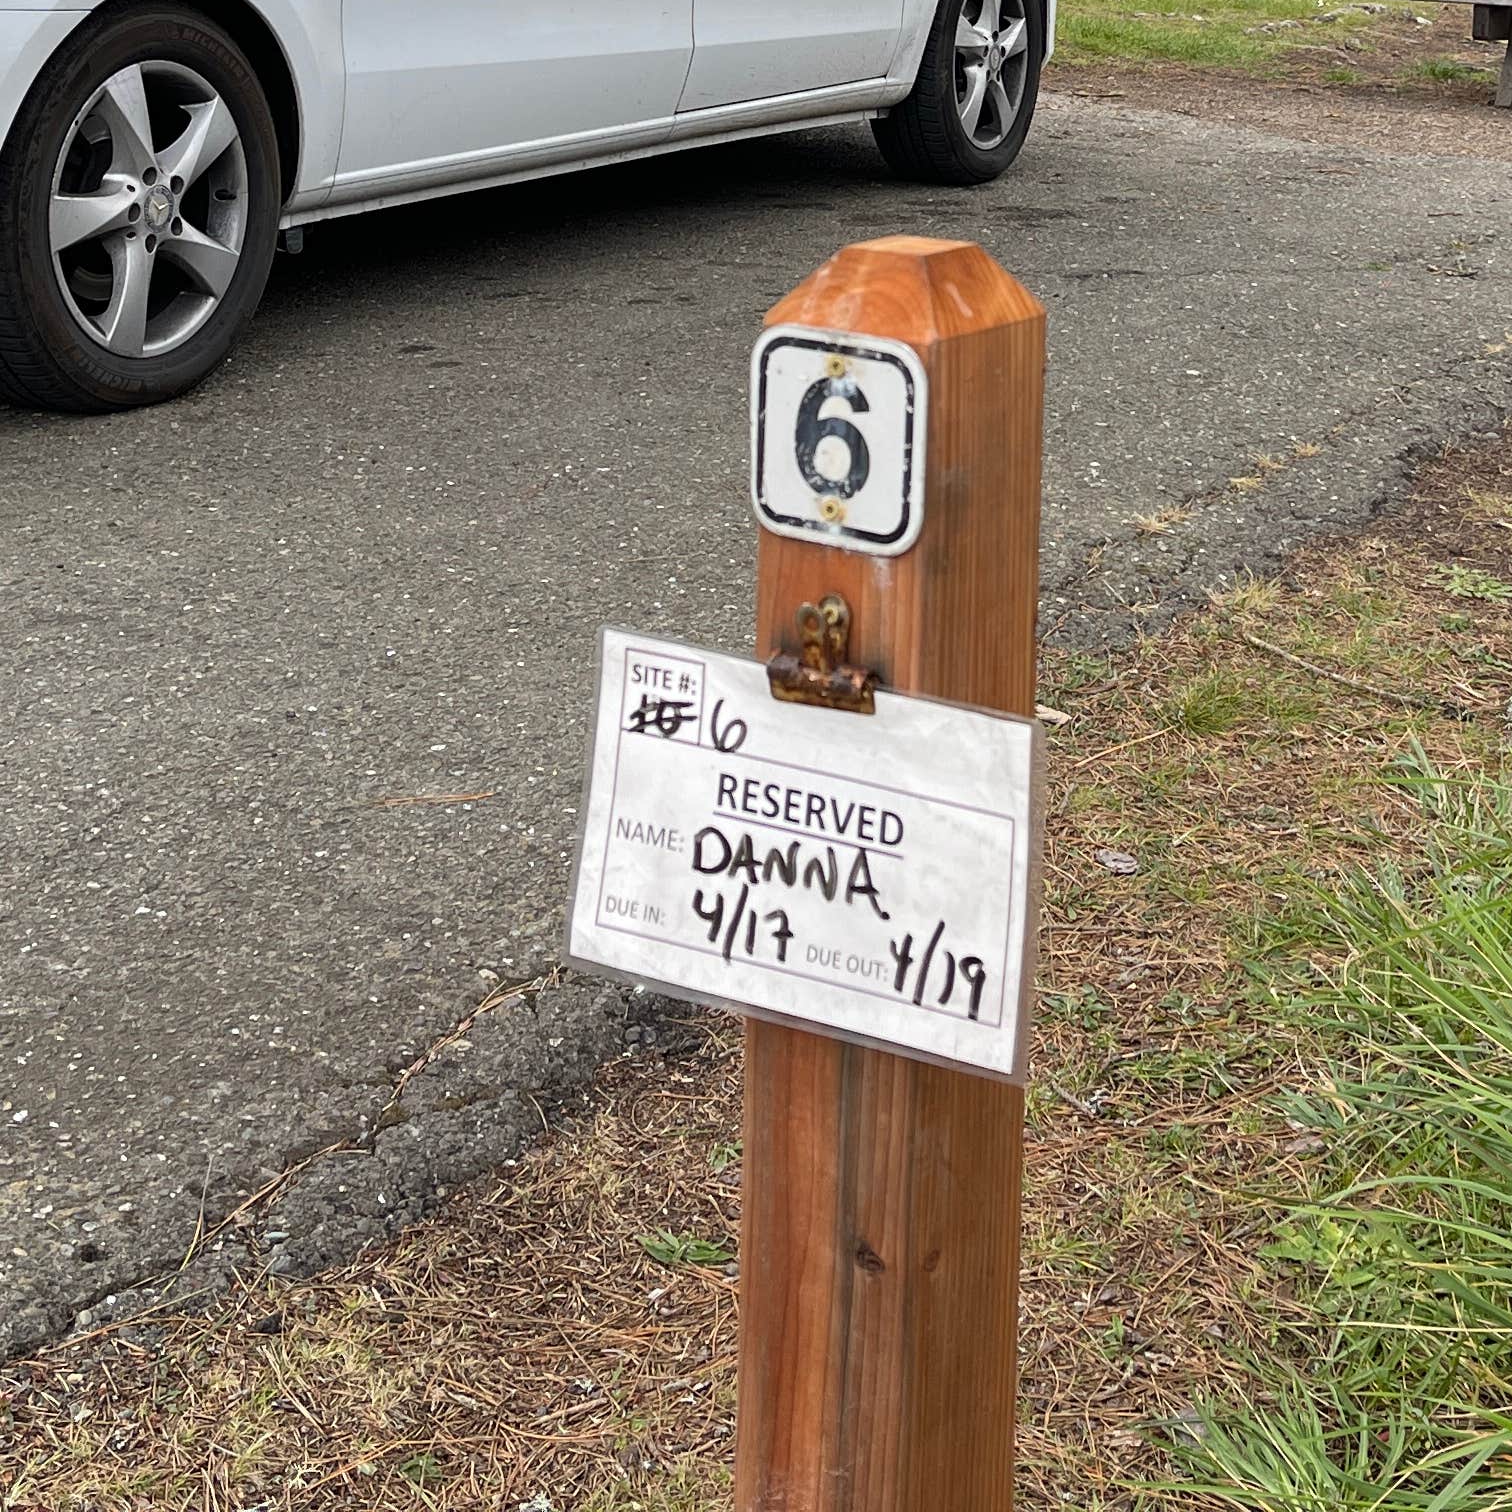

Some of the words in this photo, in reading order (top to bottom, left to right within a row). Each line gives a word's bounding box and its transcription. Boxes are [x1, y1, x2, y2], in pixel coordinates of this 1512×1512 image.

[795, 376, 870, 499] 6
[631, 663, 673, 691] SITE
[710, 698, 748, 753] 6
[615, 817, 685, 854] NAME:
[716, 772, 905, 847] RESERVED
[605, 895, 640, 920] DUE
[643, 902, 667, 927] IN:
[691, 883, 795, 963] 4/17
[806, 943, 842, 971] DUE
[845, 953, 889, 983] OUT:
[889, 919, 987, 1021] 4/19
